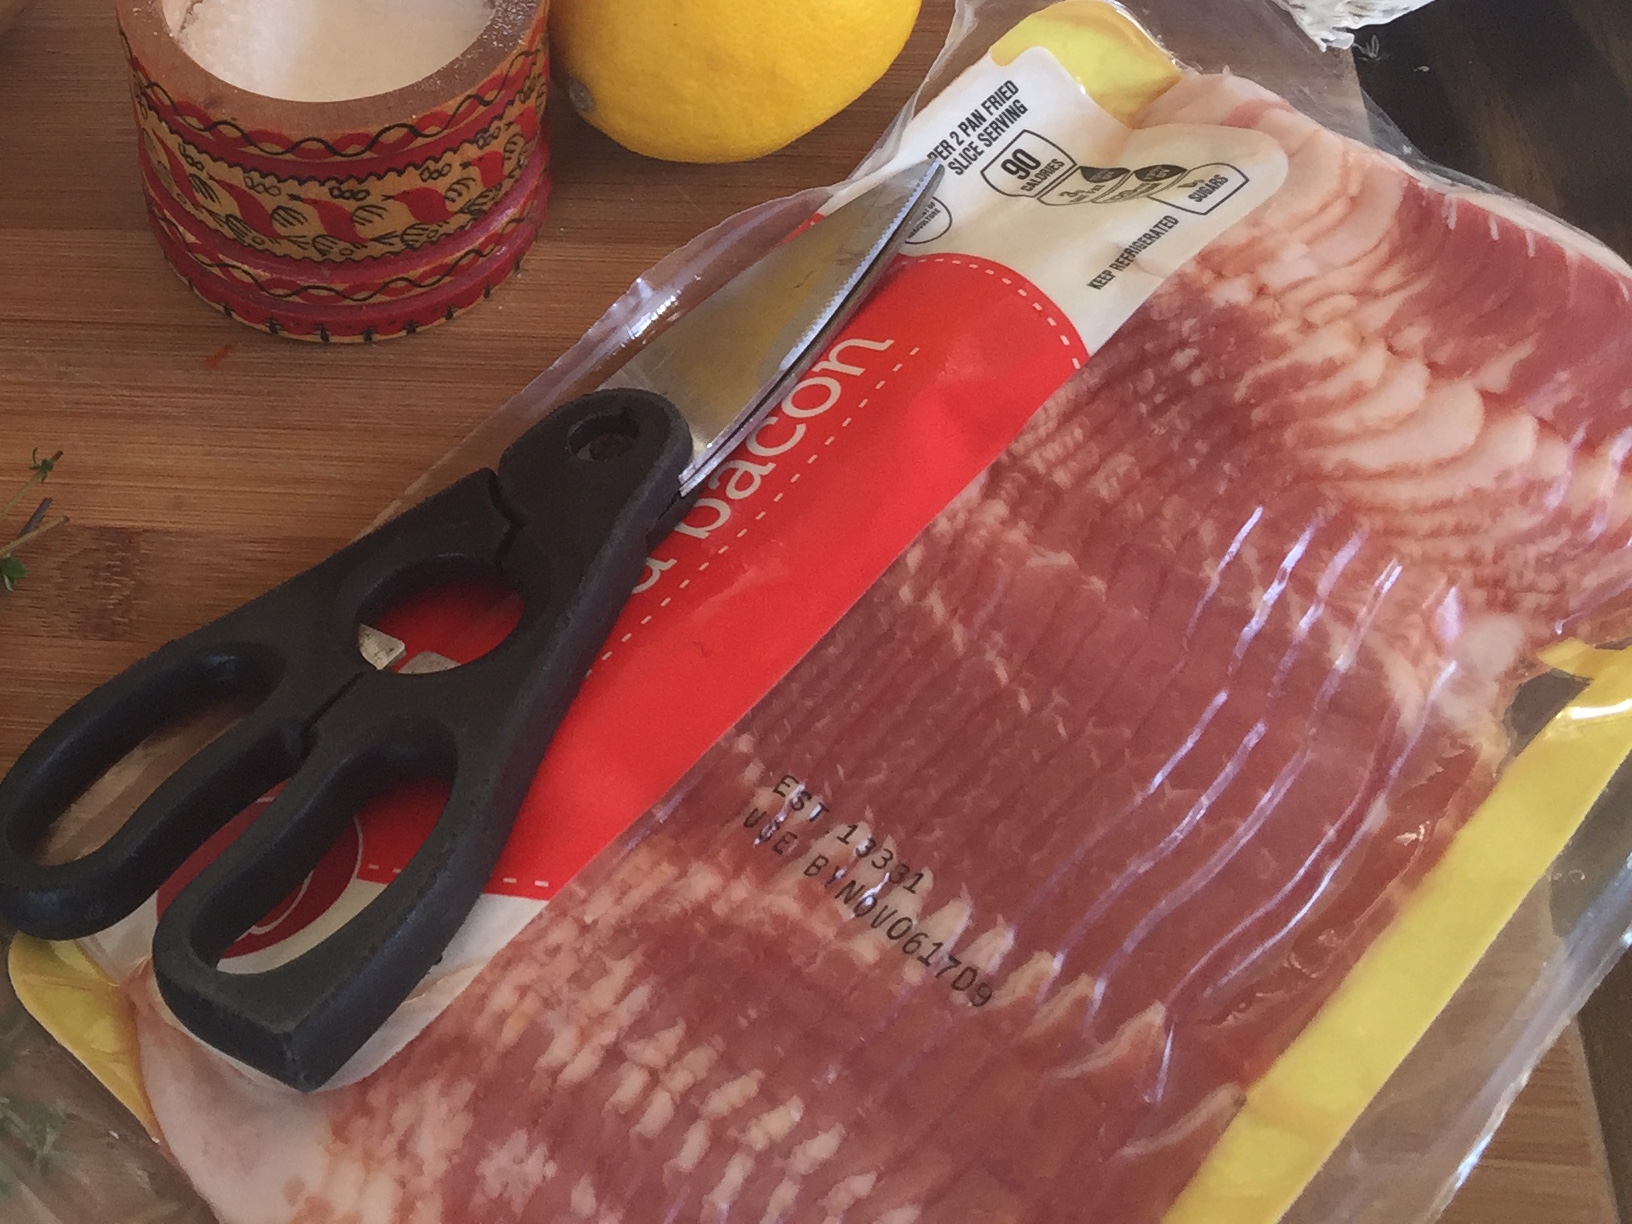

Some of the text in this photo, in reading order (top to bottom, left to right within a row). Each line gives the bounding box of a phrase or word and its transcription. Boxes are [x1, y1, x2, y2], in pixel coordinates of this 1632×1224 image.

[950, 130, 964, 146] 2
[958, 108, 987, 138] PAN
[981, 79, 1019, 115] FRIED
[948, 98, 1028, 176] SLICE SERVING
[1000, 148, 1041, 181] 90
[1021, 158, 1065, 193] CALORIES
[1187, 174, 1229, 203] SUGARS
[1086, 215, 1179, 291] KEEP REFRIGERATED
[743, 808, 798, 855] USE
